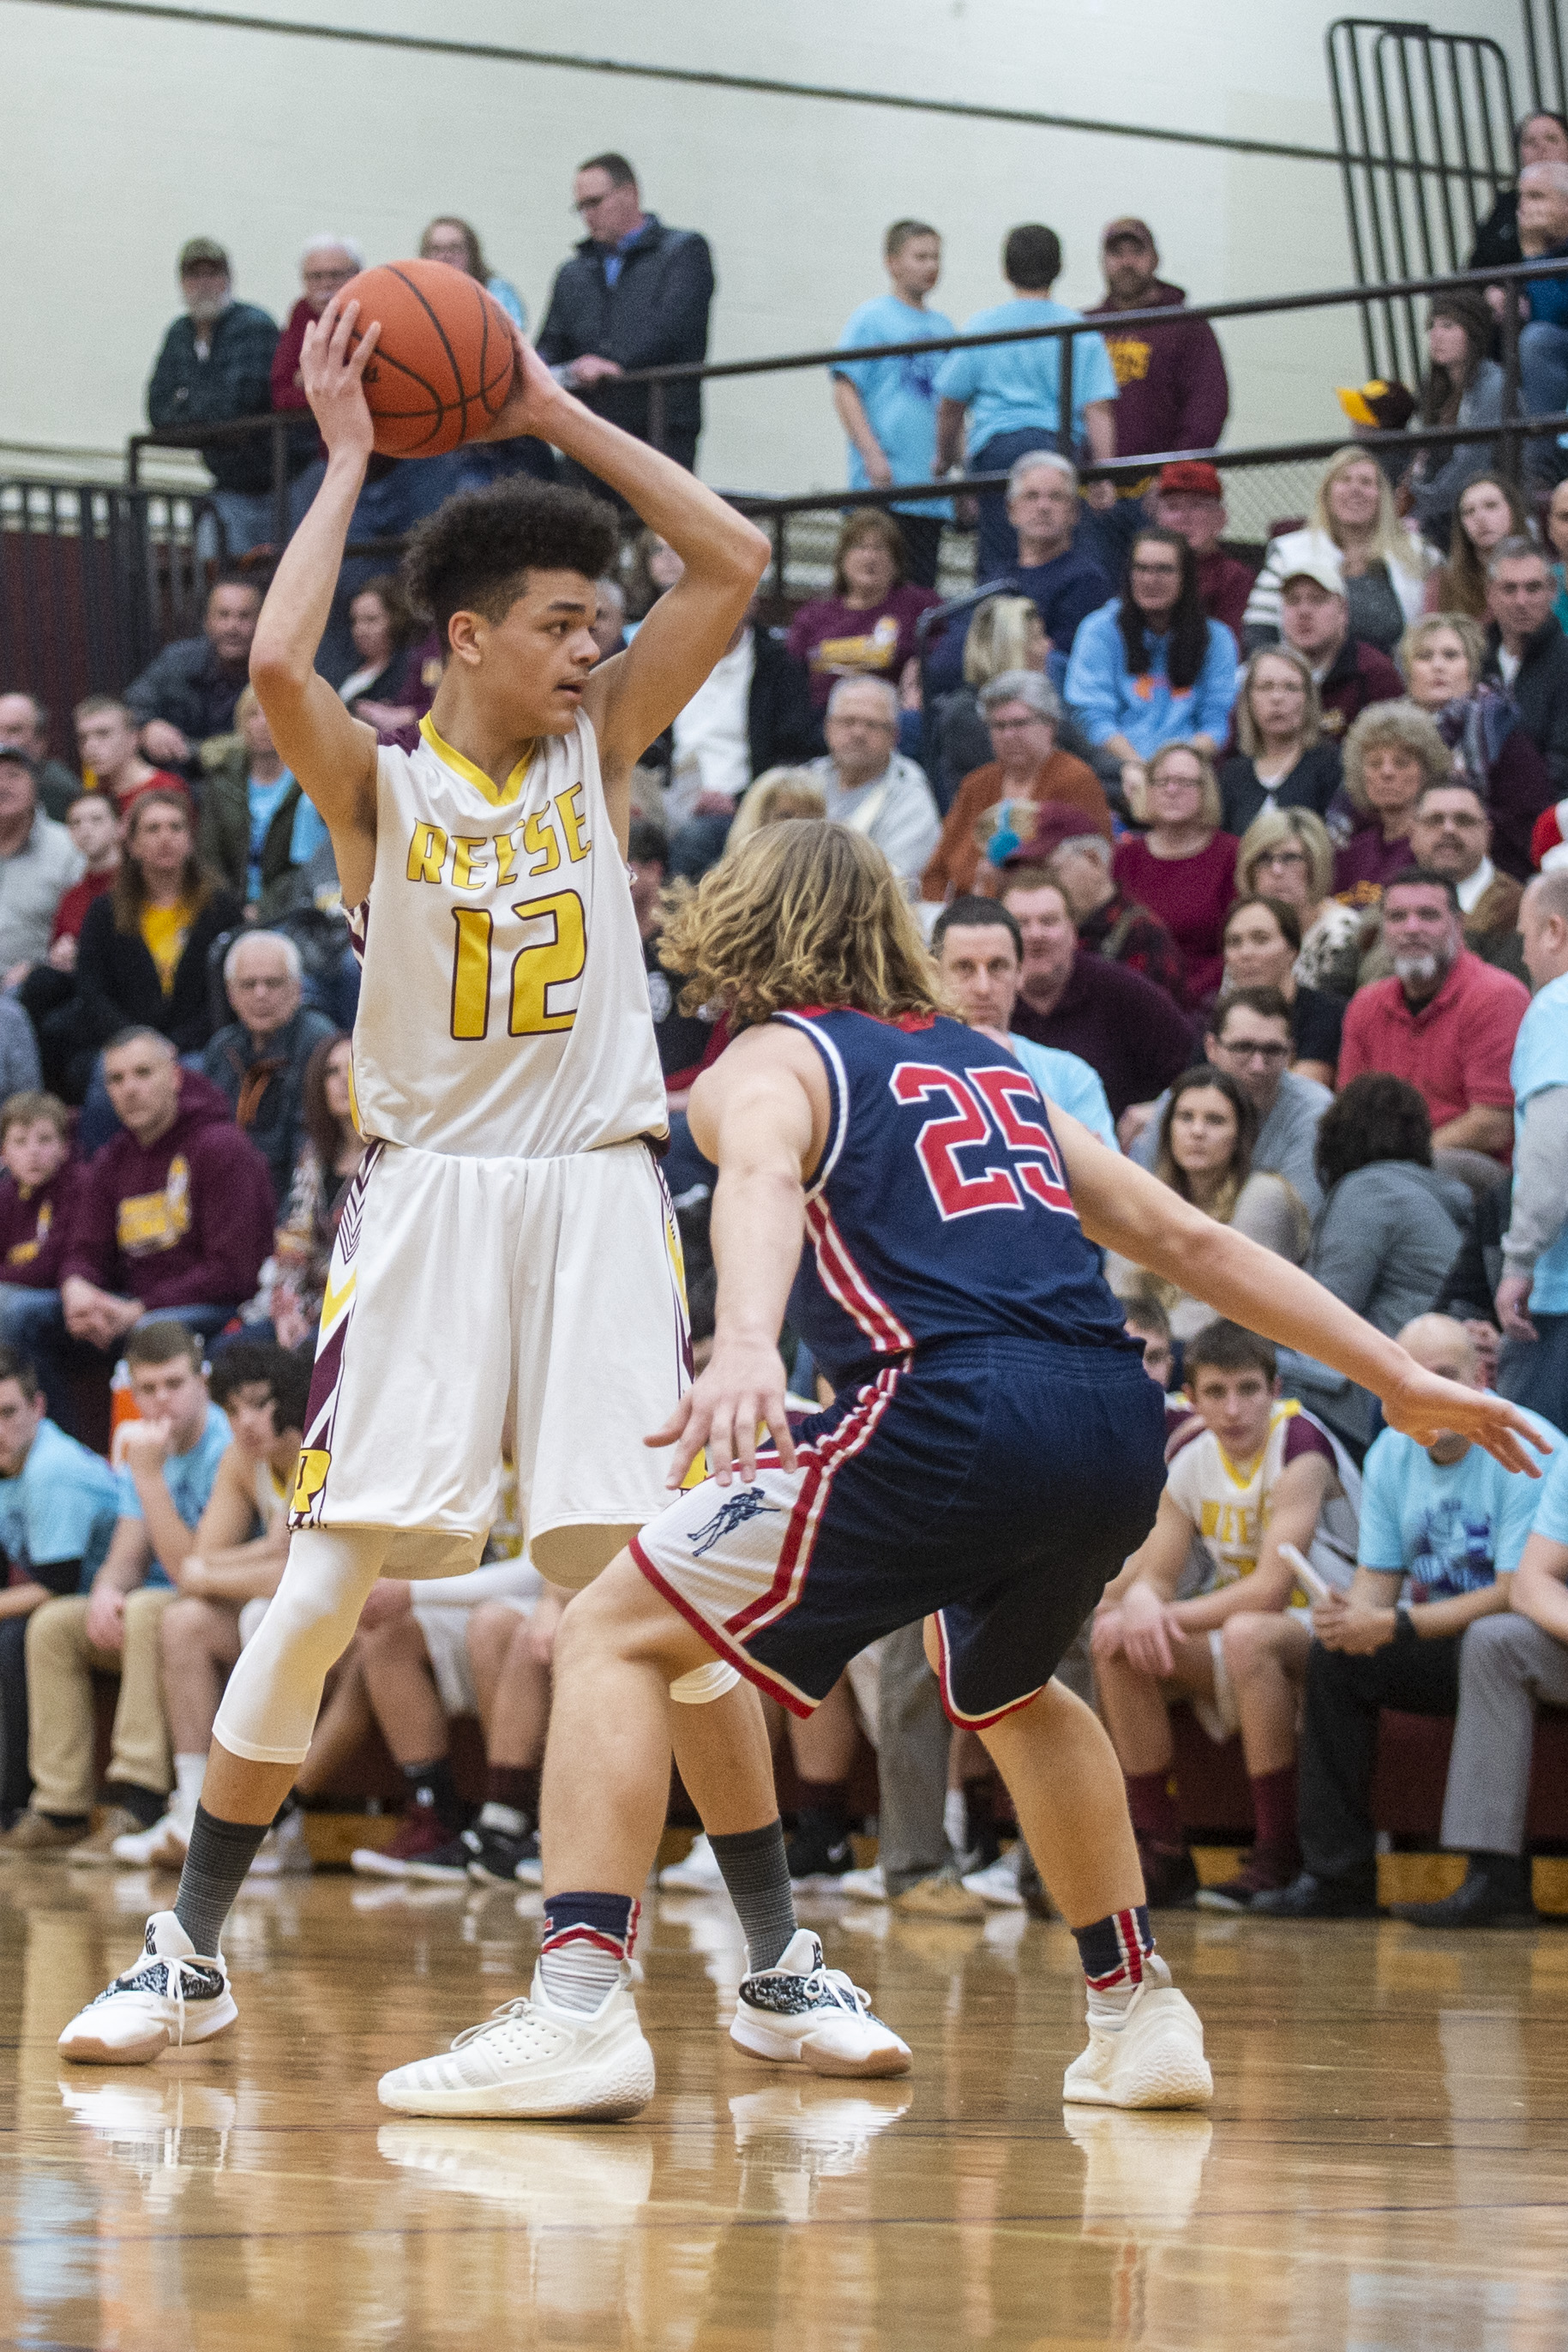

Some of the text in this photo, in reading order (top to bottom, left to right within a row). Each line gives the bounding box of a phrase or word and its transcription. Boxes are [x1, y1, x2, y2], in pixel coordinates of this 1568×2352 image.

[406, 781, 592, 889] REESE
[450, 888, 588, 1041] 12
[889, 1062, 1079, 1221] 25
